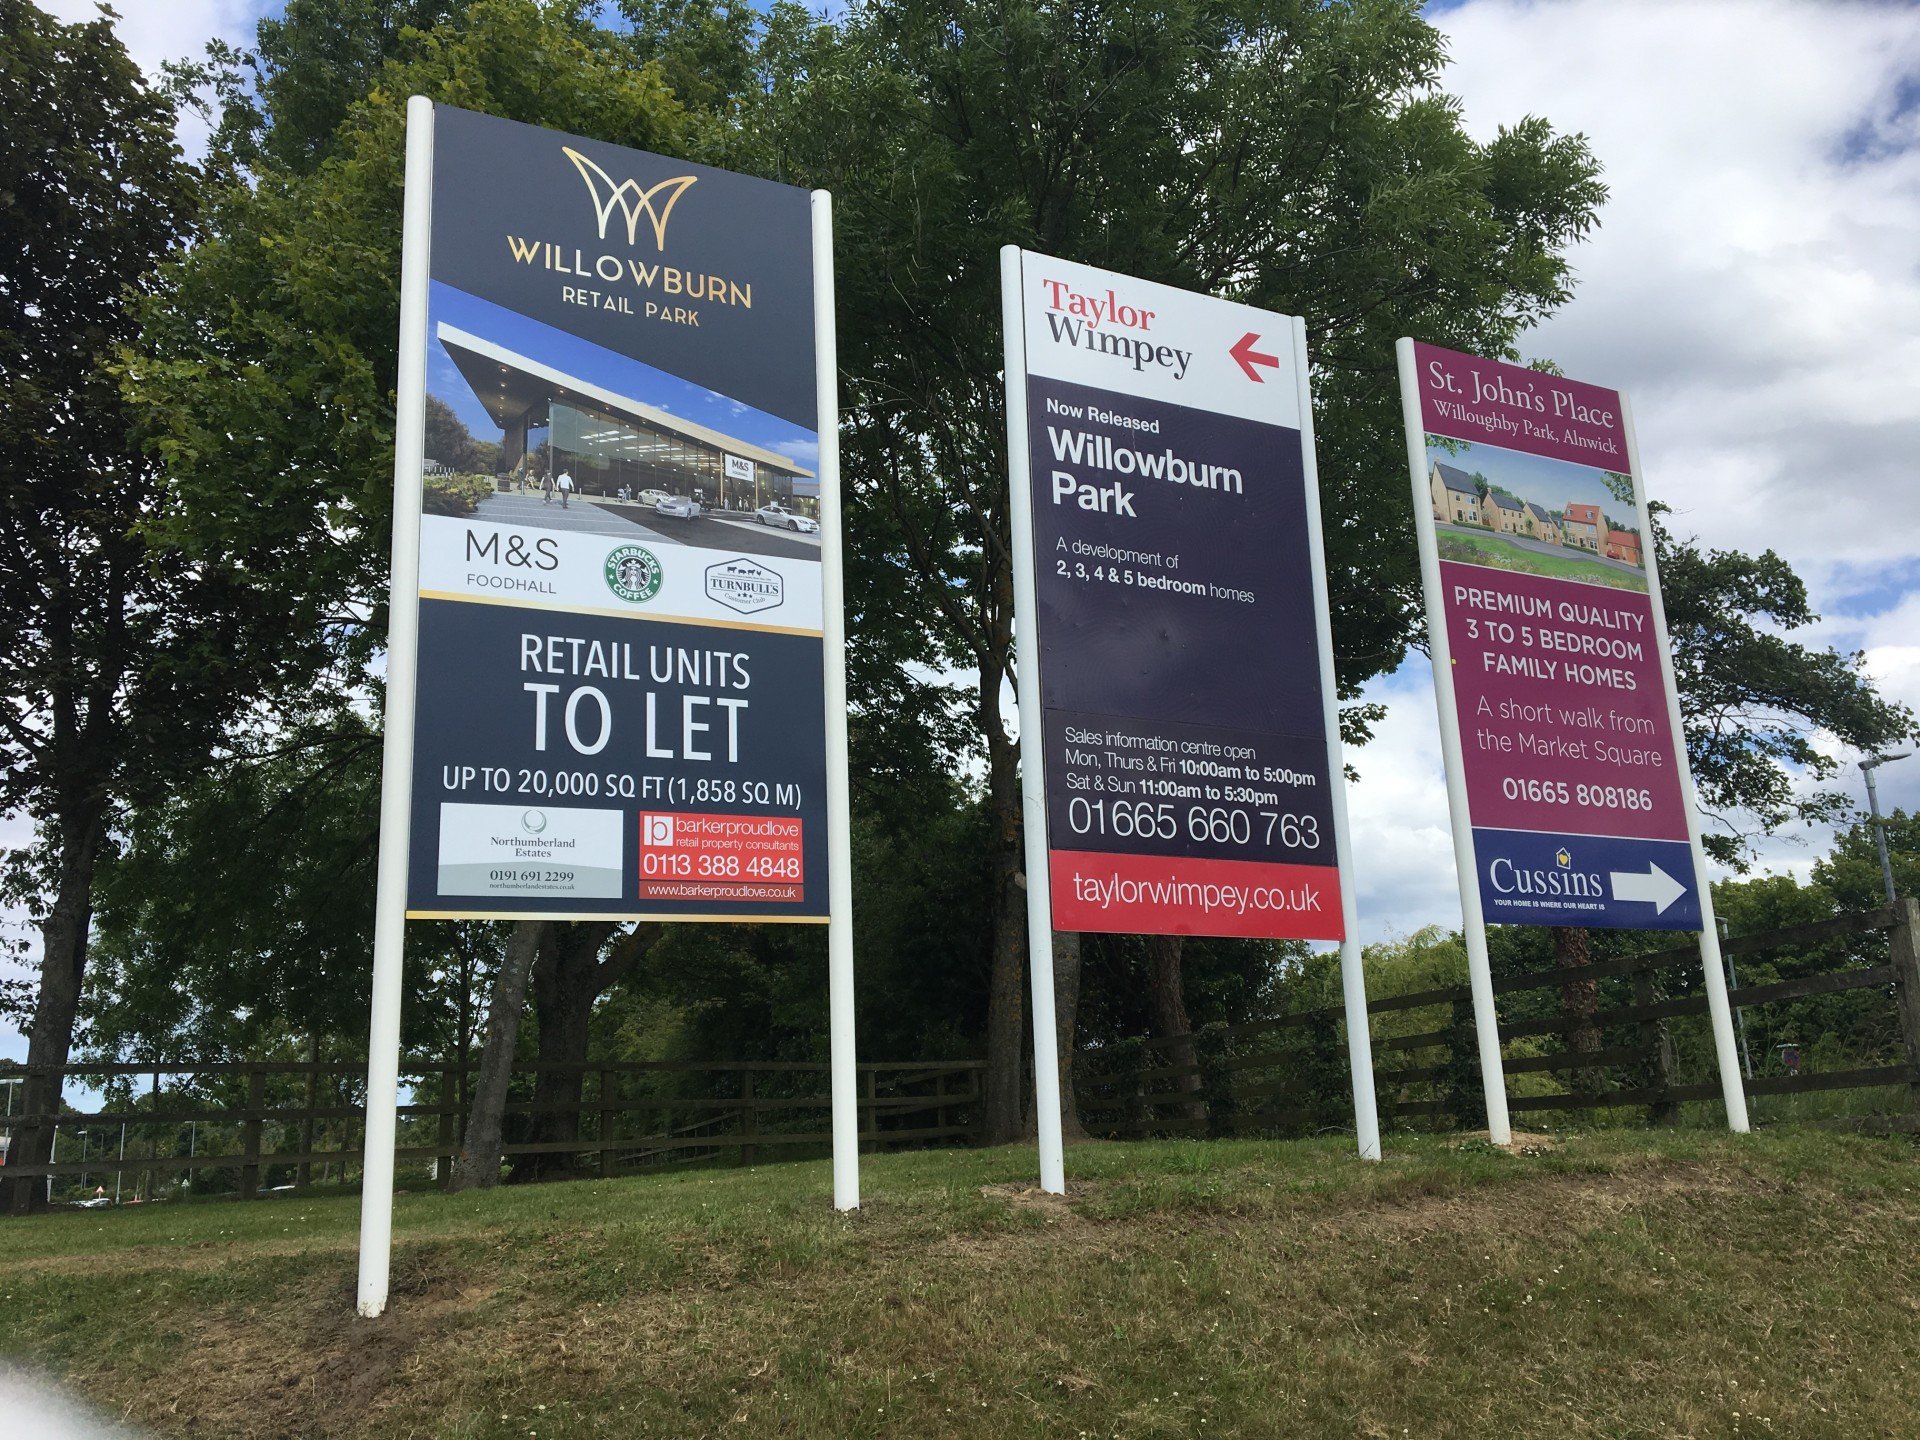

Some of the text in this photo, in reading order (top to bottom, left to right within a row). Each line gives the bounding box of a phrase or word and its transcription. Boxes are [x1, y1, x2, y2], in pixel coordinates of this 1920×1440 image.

[507, 235, 752, 308] WILLOWBURN
[563, 286, 699, 326] RETAIL PARK
[1043, 279, 1155, 331] Taylor
[1046, 312, 1192, 380] Wimpey
[1429, 361, 1614, 429] St. John's Place
[1047, 398, 1160, 434] Now Released
[1433, 399, 1618, 455] Willoughby Park, Alnwick
[732, 459, 749, 471] M&S
[1047, 426, 1242, 495] Willowburn
[1051, 470, 1138, 518] Park
[466, 529, 559, 570] M&S
[608, 548, 659, 574] STARBUCKS
[1056, 536, 1179, 569] A development of
[467, 574, 556, 594] FOODHALL
[614, 584, 653, 600] COFFEE
[711, 579, 779, 594] TURNBULL'S
[1057, 560, 1255, 603] 2, 3, 4 & 5 bedroom homes
[1454, 586, 1644, 632] PREMIUM QUALITY
[1466, 619, 1643, 662] 3 TO 5 BEDROOM
[521, 633, 751, 690] RETAIL UNITS
[1483, 651, 1636, 690] FAMILY HOMES
[523, 682, 749, 763] TO LET
[1477, 695, 1655, 734] A short walk from
[1065, 727, 1256, 759] Sales information centre open
[1477, 729, 1662, 767] the Market Square
[443, 765, 801, 810] UP TO 20,000 SQ FT (1,858 SQ M)
[1065, 749, 1316, 787] Mon, Thurs & Fri 10:00am to 5:00pm
[1067, 773, 1278, 806] Sat & Sun 11:00am to 5:30pm
[1503, 777, 1652, 811] 01665 808186
[491, 837, 576, 848] Northumberland
[676, 817, 799, 837] barkerproudlove
[1069, 797, 1320, 849] 01665 660 763
[515, 848, 552, 857] Estates
[676, 838, 799, 851] retail property consultants
[490, 870, 574, 882] 0191 691 2299
[644, 853, 799, 878] 0113 388 4848
[1490, 858, 1603, 897] Cussins
[648, 885, 796, 898] www.barkerproudlove.co.uk
[1073, 872, 1321, 915] taylorwimpey.co.uk
